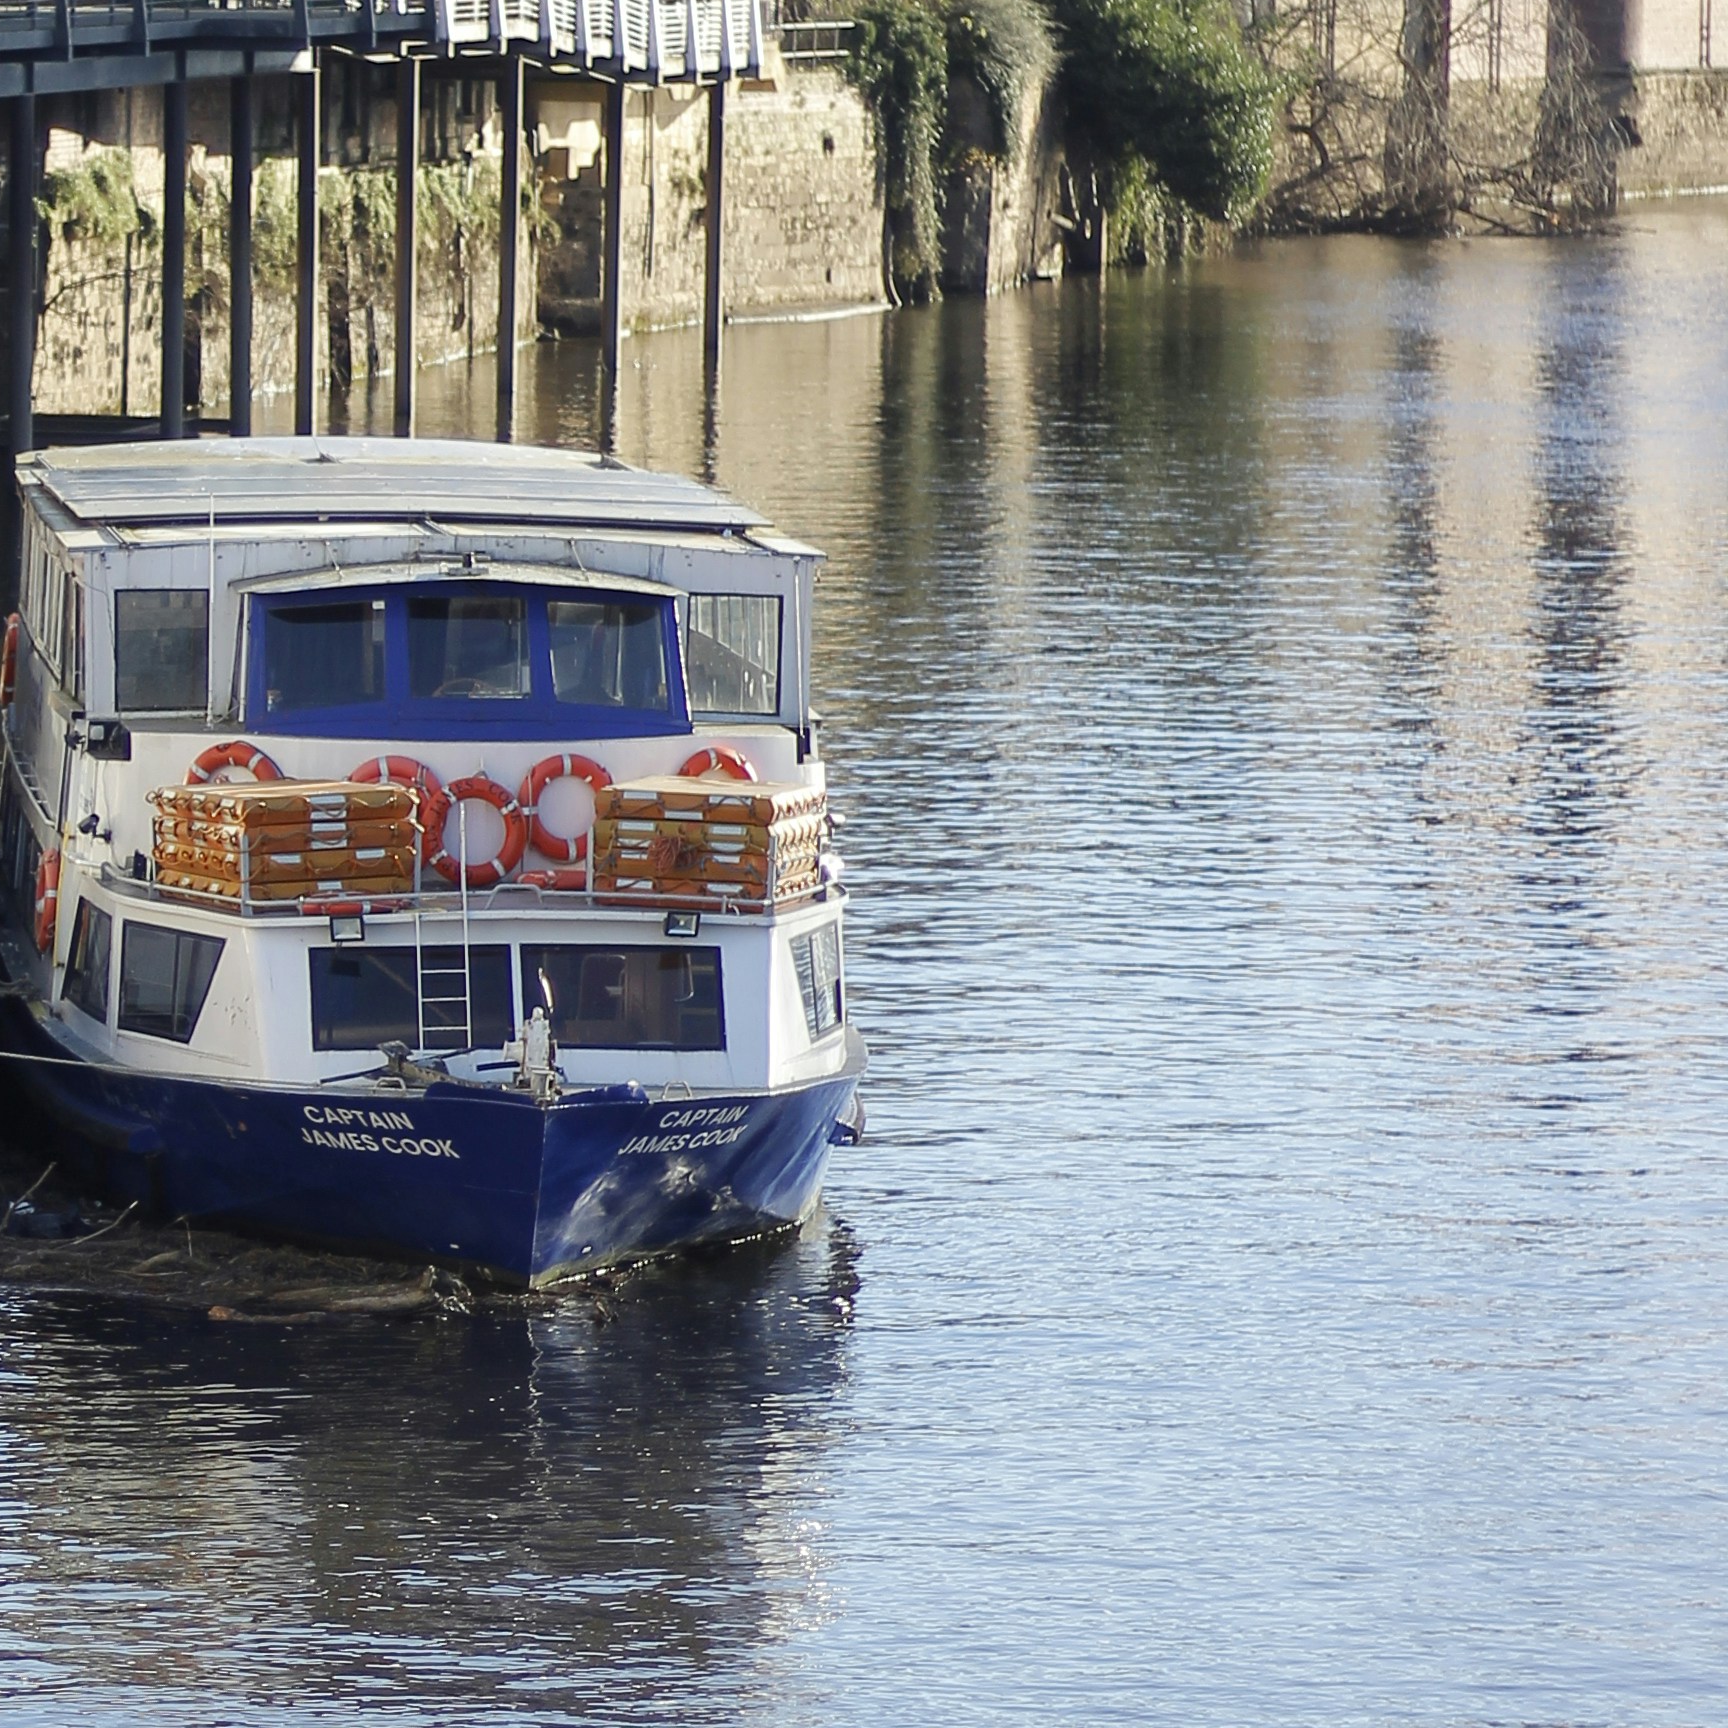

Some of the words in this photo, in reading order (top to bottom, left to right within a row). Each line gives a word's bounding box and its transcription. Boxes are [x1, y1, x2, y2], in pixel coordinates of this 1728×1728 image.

[303, 1105, 415, 1131] CAPTAIN
[659, 1104, 750, 1129] CAPTAIN
[301, 1127, 380, 1152] JAMES
[381, 1136, 461, 1159] COOK
[617, 1133, 690, 1156] JAMES
[688, 1124, 749, 1150] COOK
